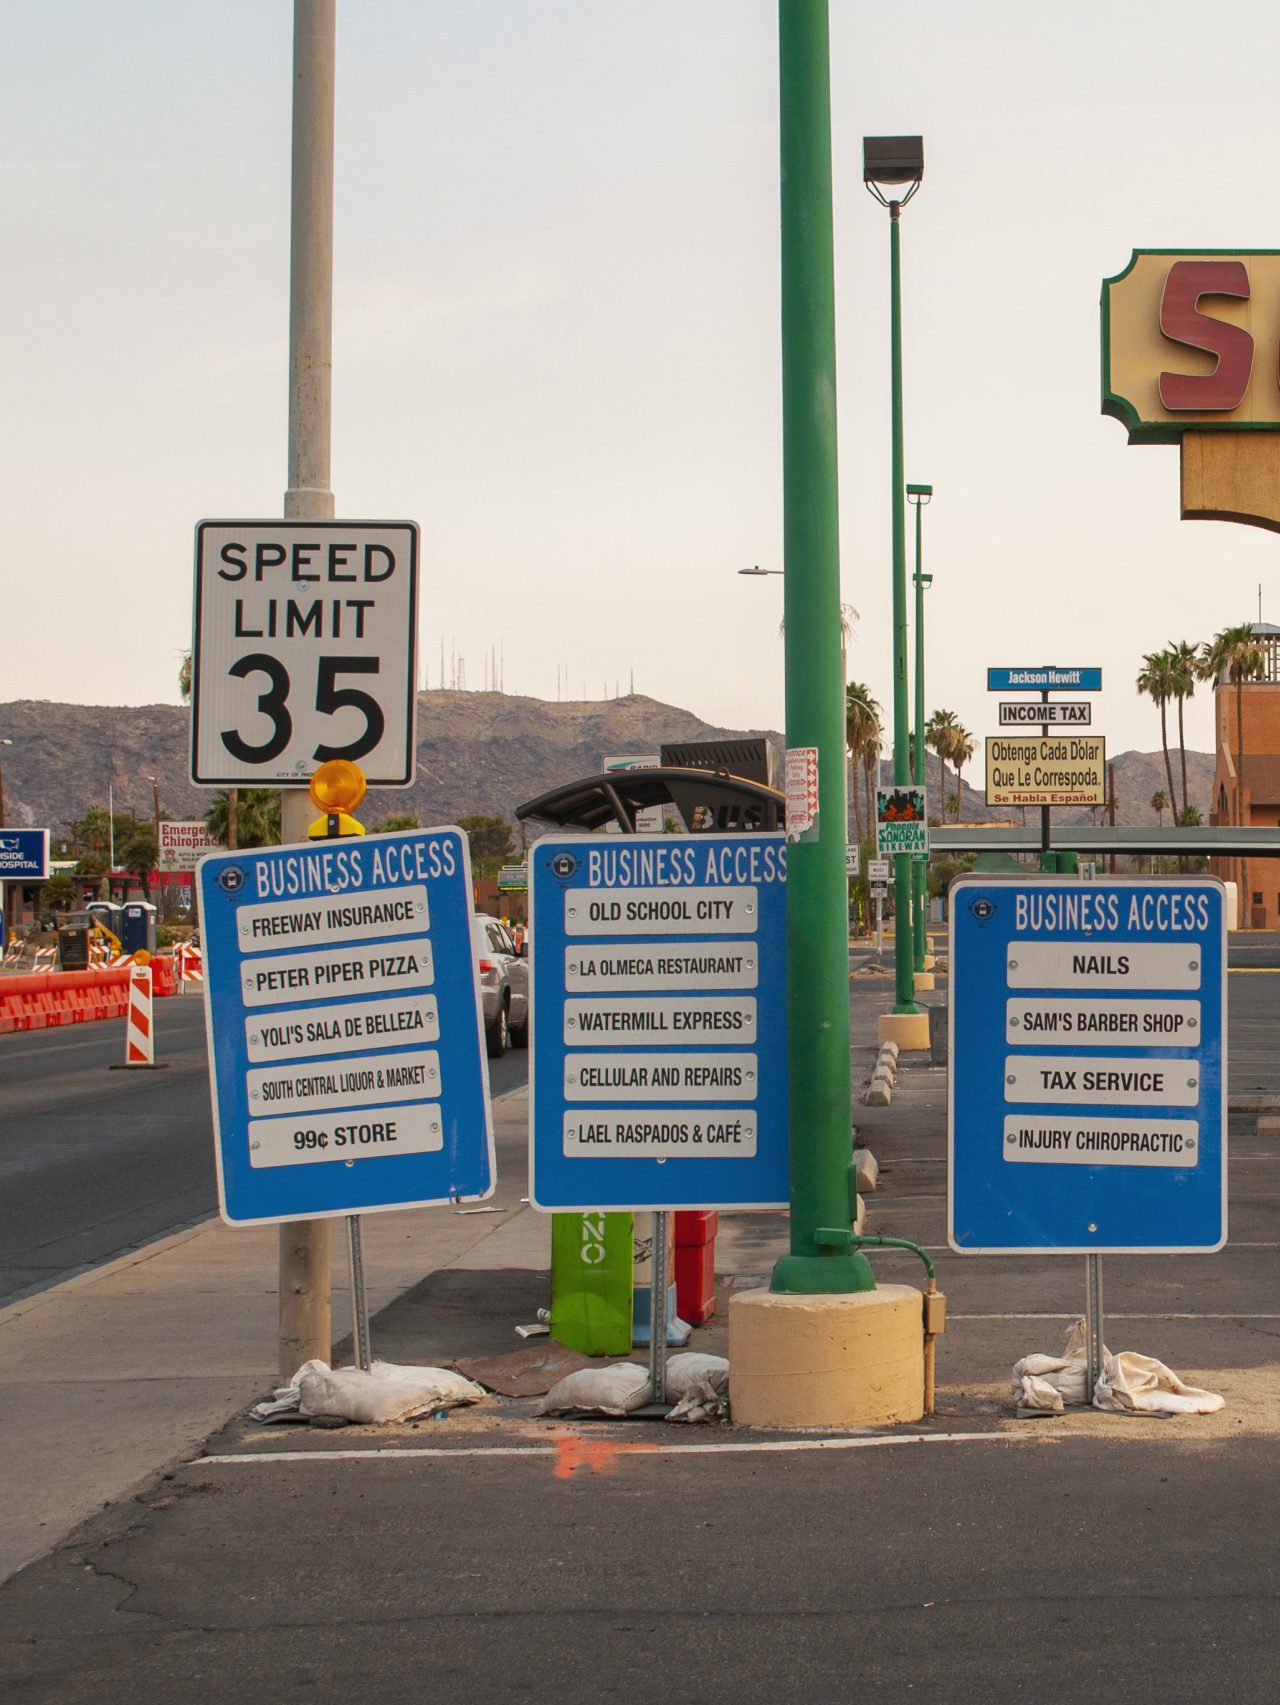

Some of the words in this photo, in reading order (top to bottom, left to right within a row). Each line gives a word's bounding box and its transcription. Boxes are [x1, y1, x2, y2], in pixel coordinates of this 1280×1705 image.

[217, 543, 396, 583] SPEED
[234, 599, 375, 639] LIMIT
[1008, 671, 1048, 684] Jackson
[1048, 671, 1081, 684] Hewitt
[220, 653, 385, 764] 35
[1003, 706, 1057, 721] INCOME
[1060, 706, 1087, 721] TAX
[992, 741, 1037, 766] Obtenga
[1040, 741, 1067, 761] Cada
[993, 767, 1015, 788] Que
[1018, 767, 1031, 787] Le
[1034, 767, 1102, 791] Correspoda.
[994, 794, 1009, 803] Se
[1012, 794, 1047, 803] Habla
[1051, 793, 1097, 804] Español
[162, 824, 207, 837] Emerge
[878, 829, 925, 843] SONORAN
[162, 836, 218, 848] Chiroprac
[878, 842, 926, 851] BIKEWAY
[0, 861, 39, 869] OSPITAL
[255, 850, 364, 898] BUSINESS
[371, 839, 456, 885] ACCESS
[588, 848, 696, 887] BUSINESS
[704, 846, 787, 884] ACCESS
[252, 911, 322, 937] FREEWAY
[327, 900, 414, 929] INSURANCE
[589, 902, 621, 921] OLD
[626, 901, 691, 921] SCHOOL
[696, 900, 734, 920] CITY
[1016, 894, 1119, 931] BUSINESS
[1128, 894, 1209, 931] ACCESS
[256, 967, 310, 991] PETER
[314, 961, 364, 984] PIPER
[369, 955, 419, 978] PIZZA
[580, 960, 596, 976] LA
[600, 958, 654, 976] OLMECA
[658, 957, 743, 974] RESTAURANT
[1072, 955, 1130, 975] NAILS
[260, 1024, 304, 1047] YOLI'S
[307, 1019, 342, 1041] SALA
[345, 1017, 363, 1036] DE
[366, 1010, 424, 1034] BELLEZA
[578, 1012, 668, 1031] WATERMILL
[673, 1011, 743, 1030] EXPRESS
[1023, 1012, 1073, 1032] SAM'S
[1077, 1013, 1138, 1033] BARBER
[1143, 1014, 1184, 1033] SHOP
[262, 1080, 293, 1101] SOUTH
[295, 1075, 339, 1098] CENTRAL
[340, 1070, 375, 1093] LIQUOR
[377, 1069, 385, 1088] &
[386, 1065, 426, 1087] MARKET
[580, 1067, 648, 1087] CELLULAR
[651, 1067, 680, 1086] AND
[684, 1067, 742, 1086] REPAIRS
[1040, 1070, 1077, 1090] TAX
[1082, 1071, 1164, 1092] SERVICE
[293, 1130, 329, 1150] 99¢
[334, 1122, 397, 1146] STORE
[578, 1124, 612, 1143] LAEL
[616, 1124, 688, 1143] RASPADOS
[692, 1124, 703, 1143] &
[706, 1120, 741, 1143] CAFÉ
[1019, 1129, 1072, 1150] INJURY
[1076, 1131, 1183, 1153] CHIROPRACTIC
